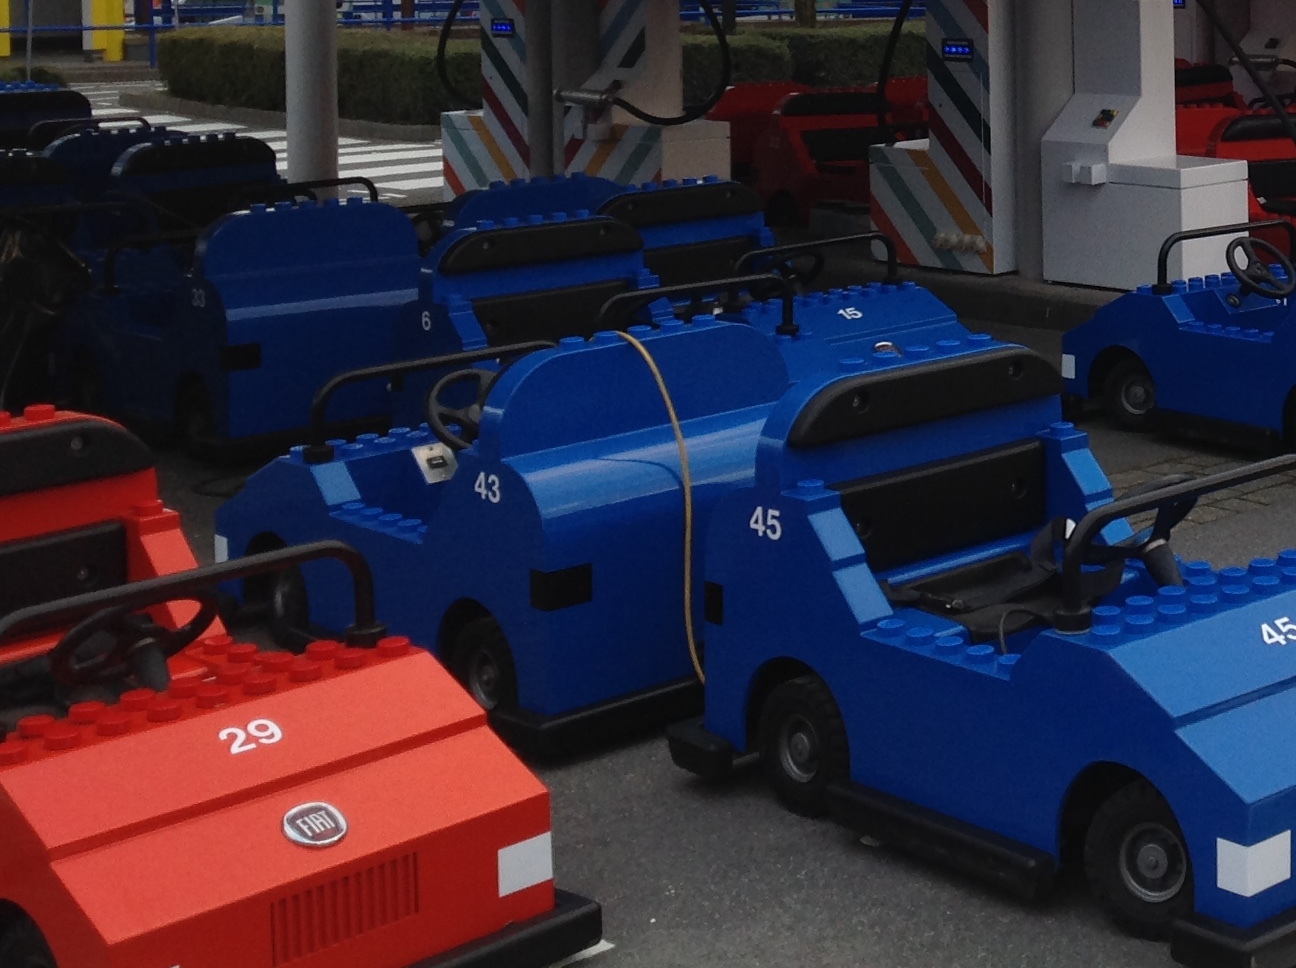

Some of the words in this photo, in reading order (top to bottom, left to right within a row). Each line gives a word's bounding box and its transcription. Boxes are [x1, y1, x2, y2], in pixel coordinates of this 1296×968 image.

[421, 311, 432, 331] 6
[837, 306, 863, 320] 15
[474, 471, 501, 504] 43
[749, 506, 782, 540] 45
[218, 718, 283, 755] 29
[296, 810, 336, 837] FIAT
